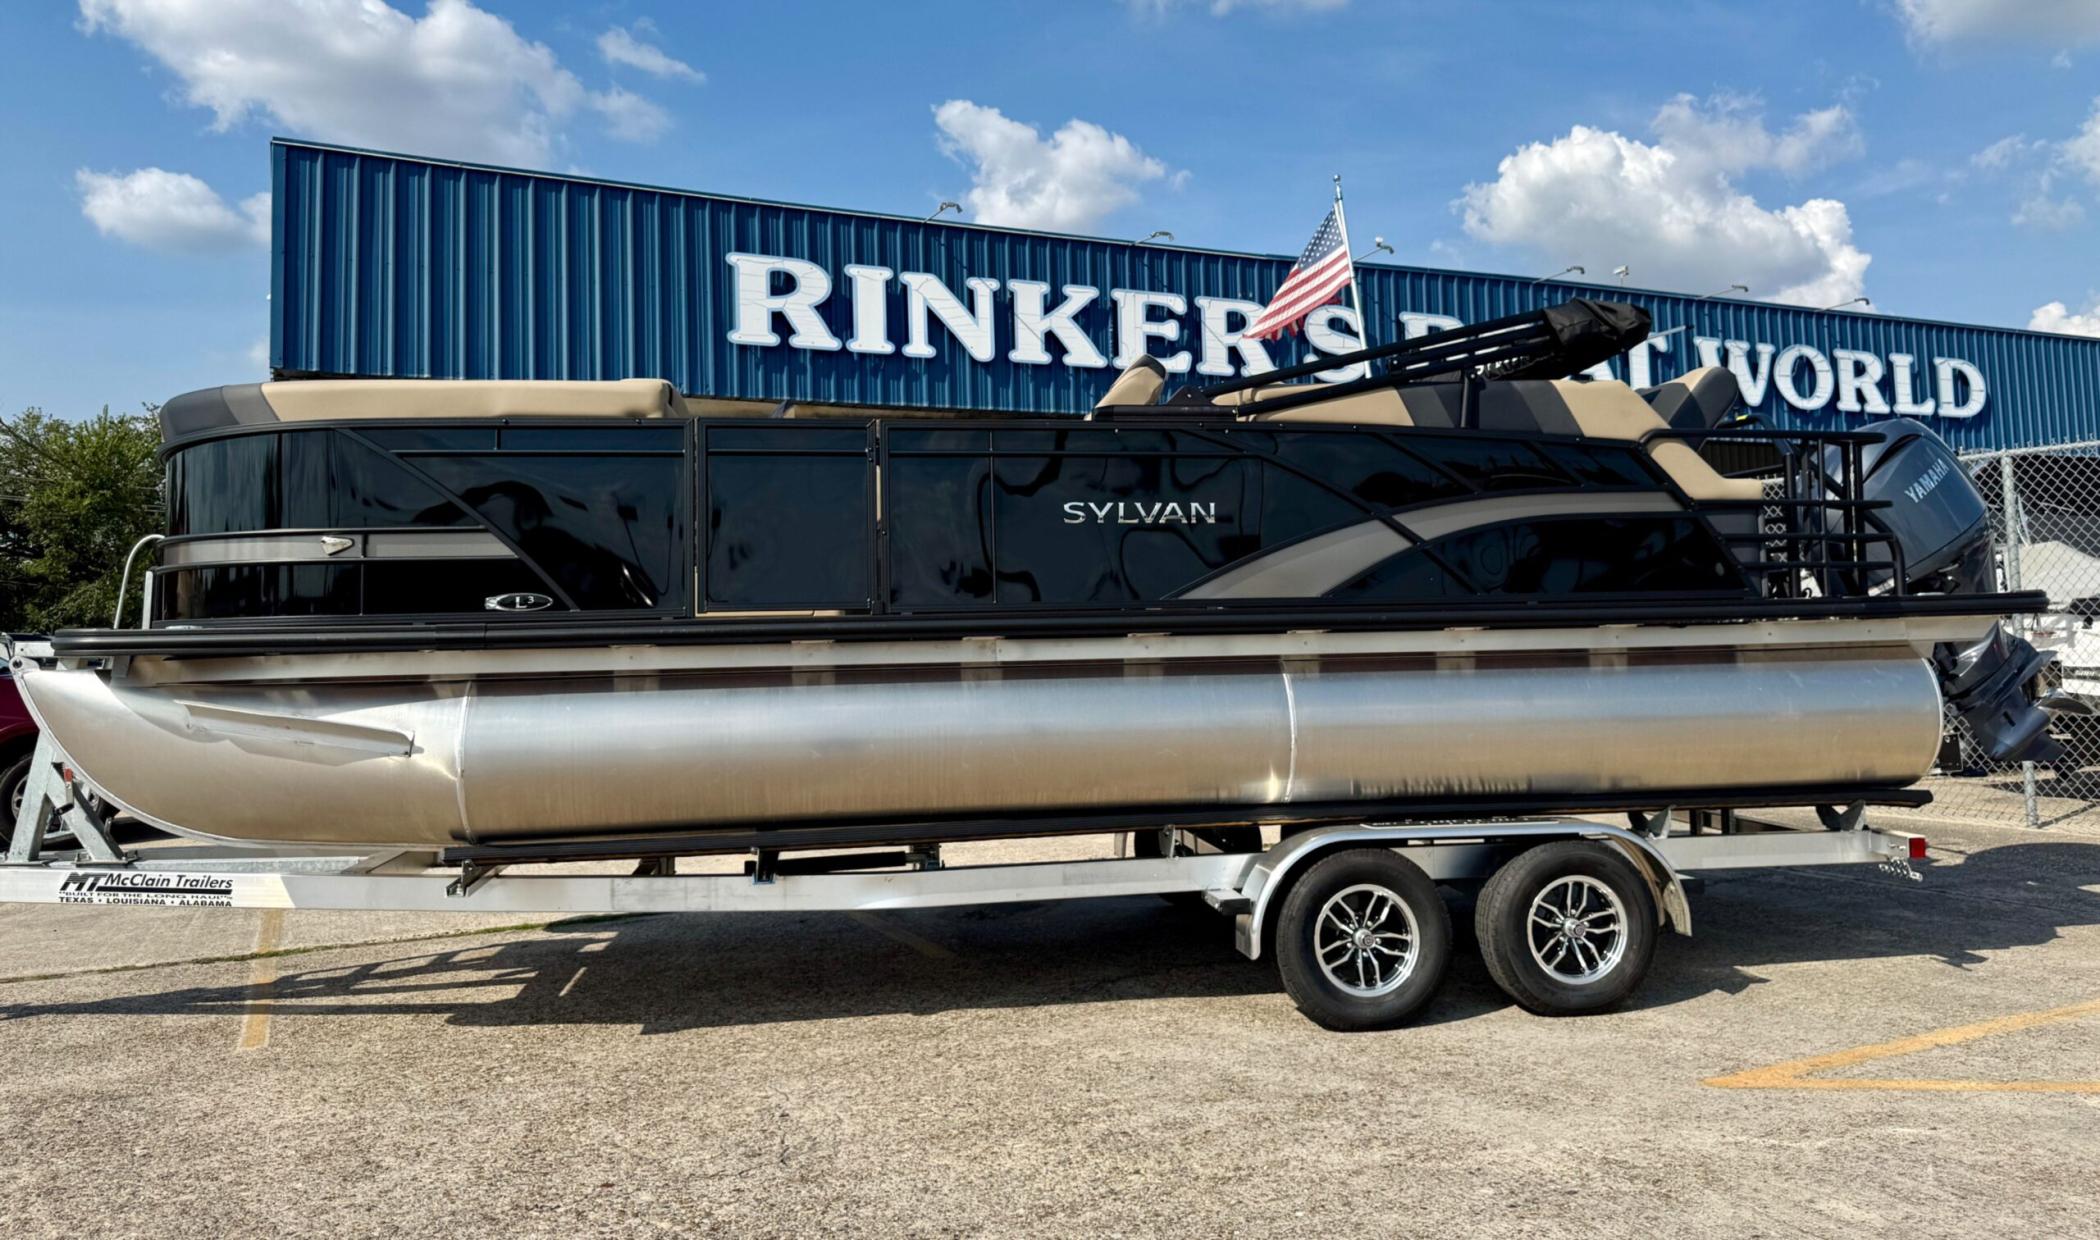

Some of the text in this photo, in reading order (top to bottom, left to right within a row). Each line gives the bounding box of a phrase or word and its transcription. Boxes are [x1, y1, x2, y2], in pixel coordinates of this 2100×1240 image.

[1693, 336, 1987, 418] WORLD
[1904, 458, 1950, 503] YAMAHA
[1063, 502, 1216, 523] SYLVAN
[104, 873, 234, 889] McClain Trailers
